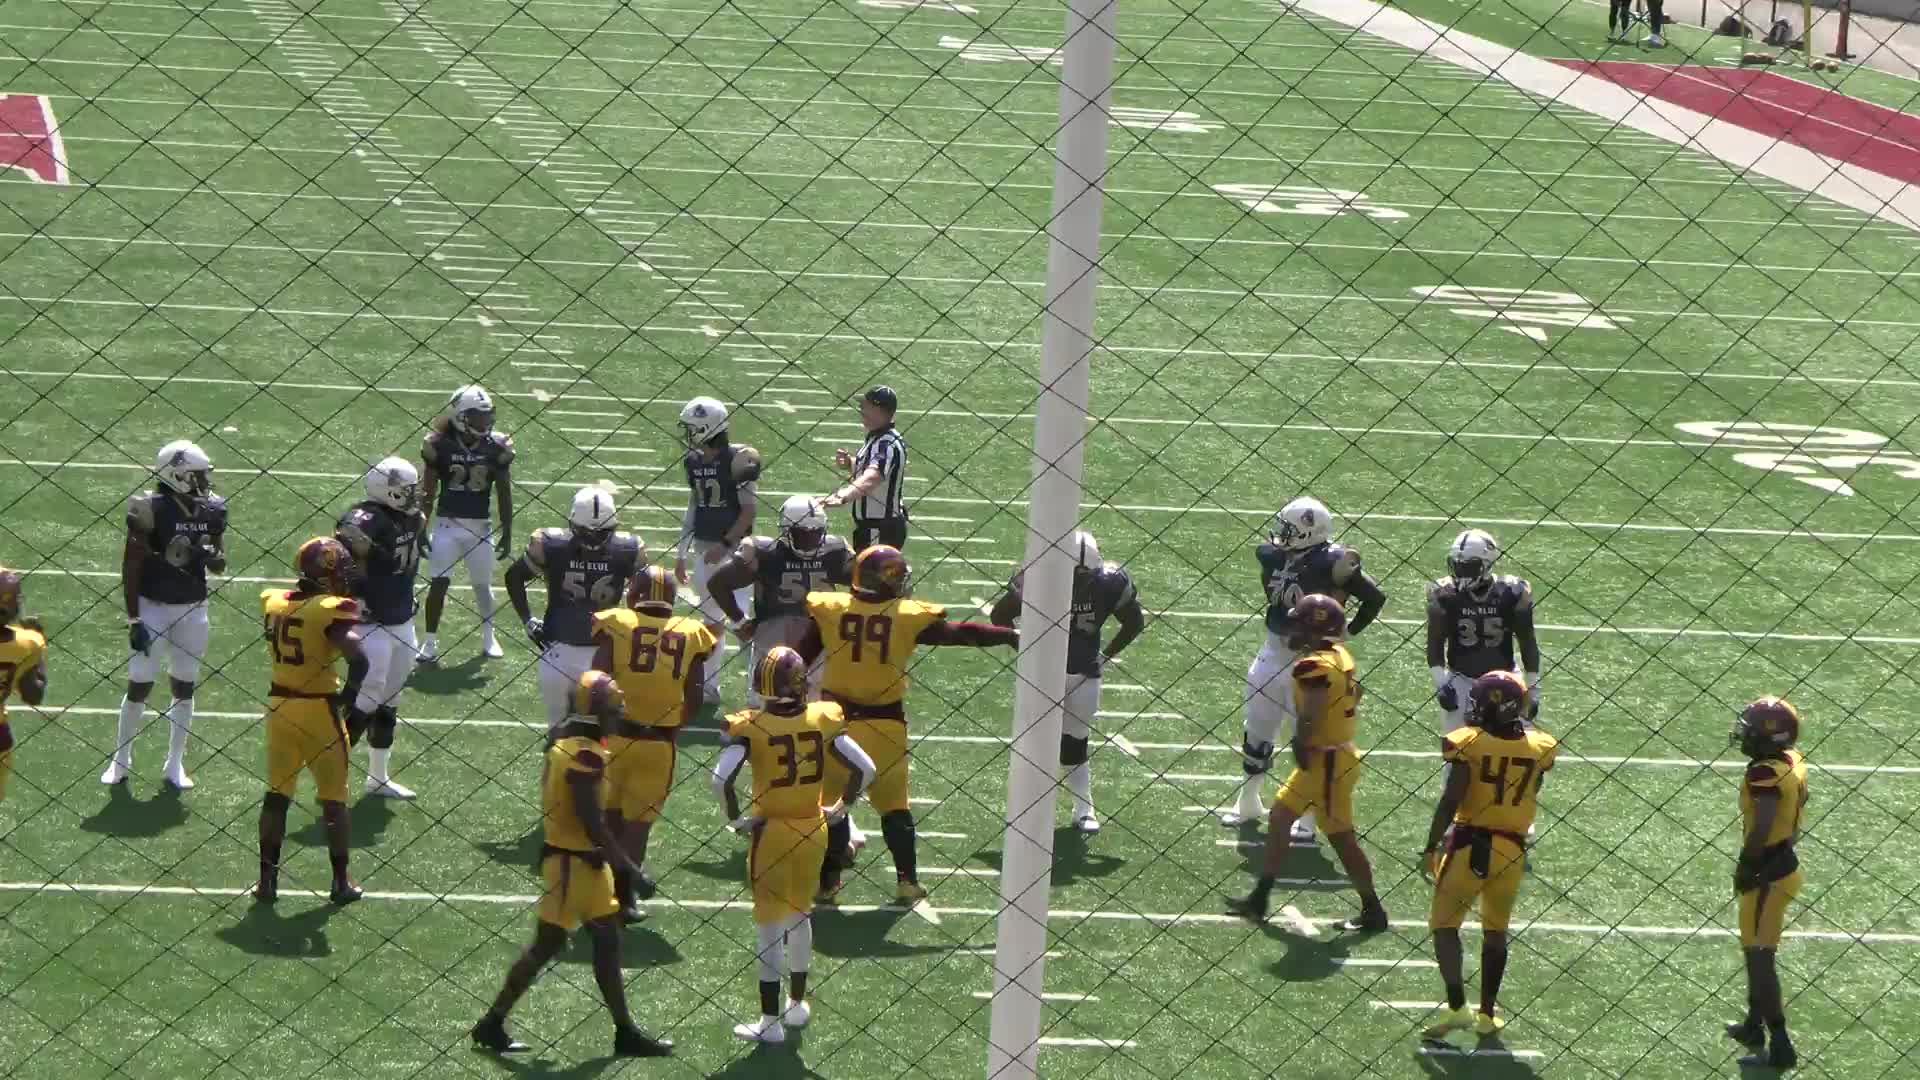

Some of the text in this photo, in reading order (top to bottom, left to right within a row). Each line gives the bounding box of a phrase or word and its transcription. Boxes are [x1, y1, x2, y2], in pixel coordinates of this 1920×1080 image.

[696, 479, 727, 507] 12
[569, 560, 585, 570] BIG
[562, 571, 616, 606] 56
[629, 626, 686, 681] 69
[838, 613, 893, 665] 99
[1457, 616, 1504, 648] 35
[768, 730, 824, 788] 33
[1480, 754, 1537, 807] 47
